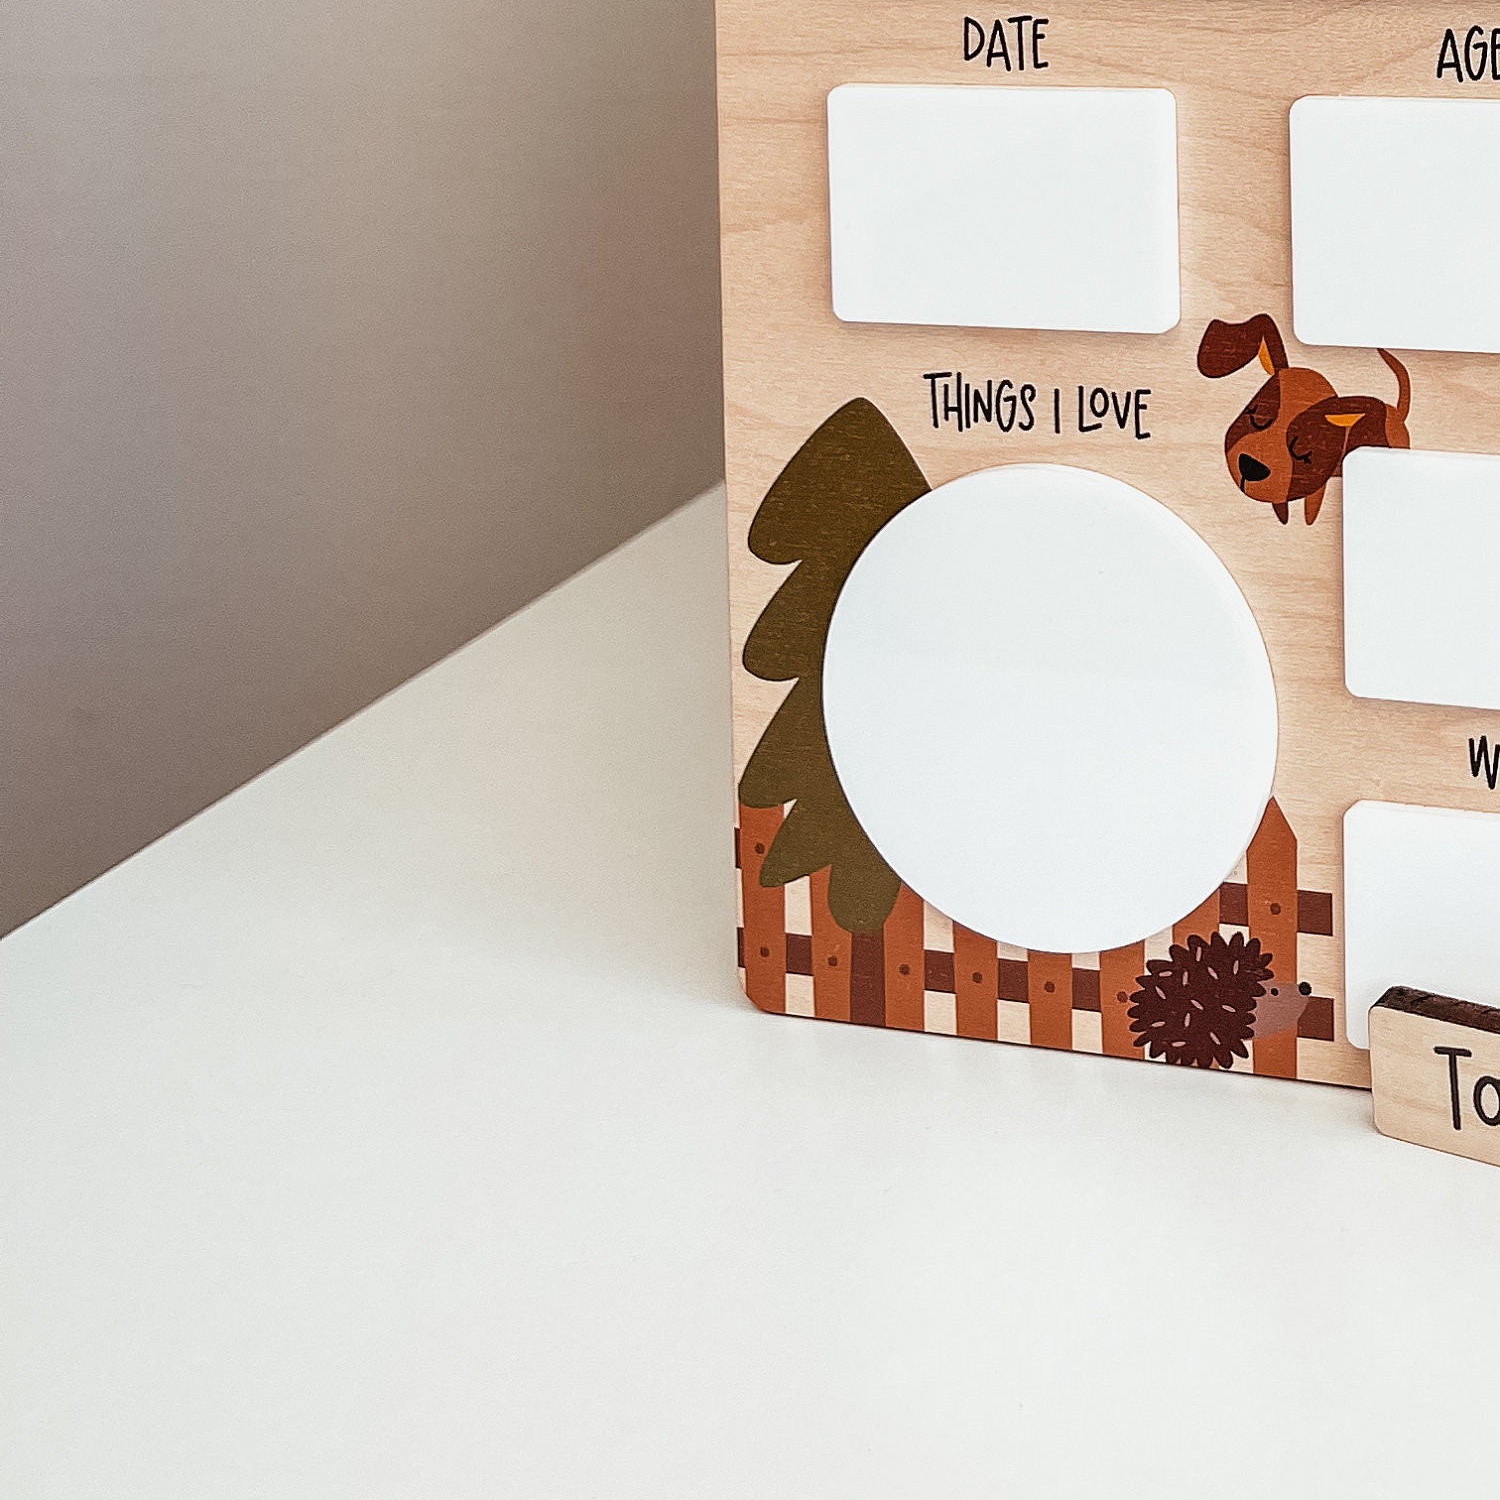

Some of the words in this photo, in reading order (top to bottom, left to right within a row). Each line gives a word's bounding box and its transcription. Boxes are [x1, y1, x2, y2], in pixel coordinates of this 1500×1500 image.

[963, 15, 1050, 72] DATE
[922, 371, 1036, 433] THINGS
[1053, 388, 1061, 434] I
[1077, 385, 1152, 440] LOVE
